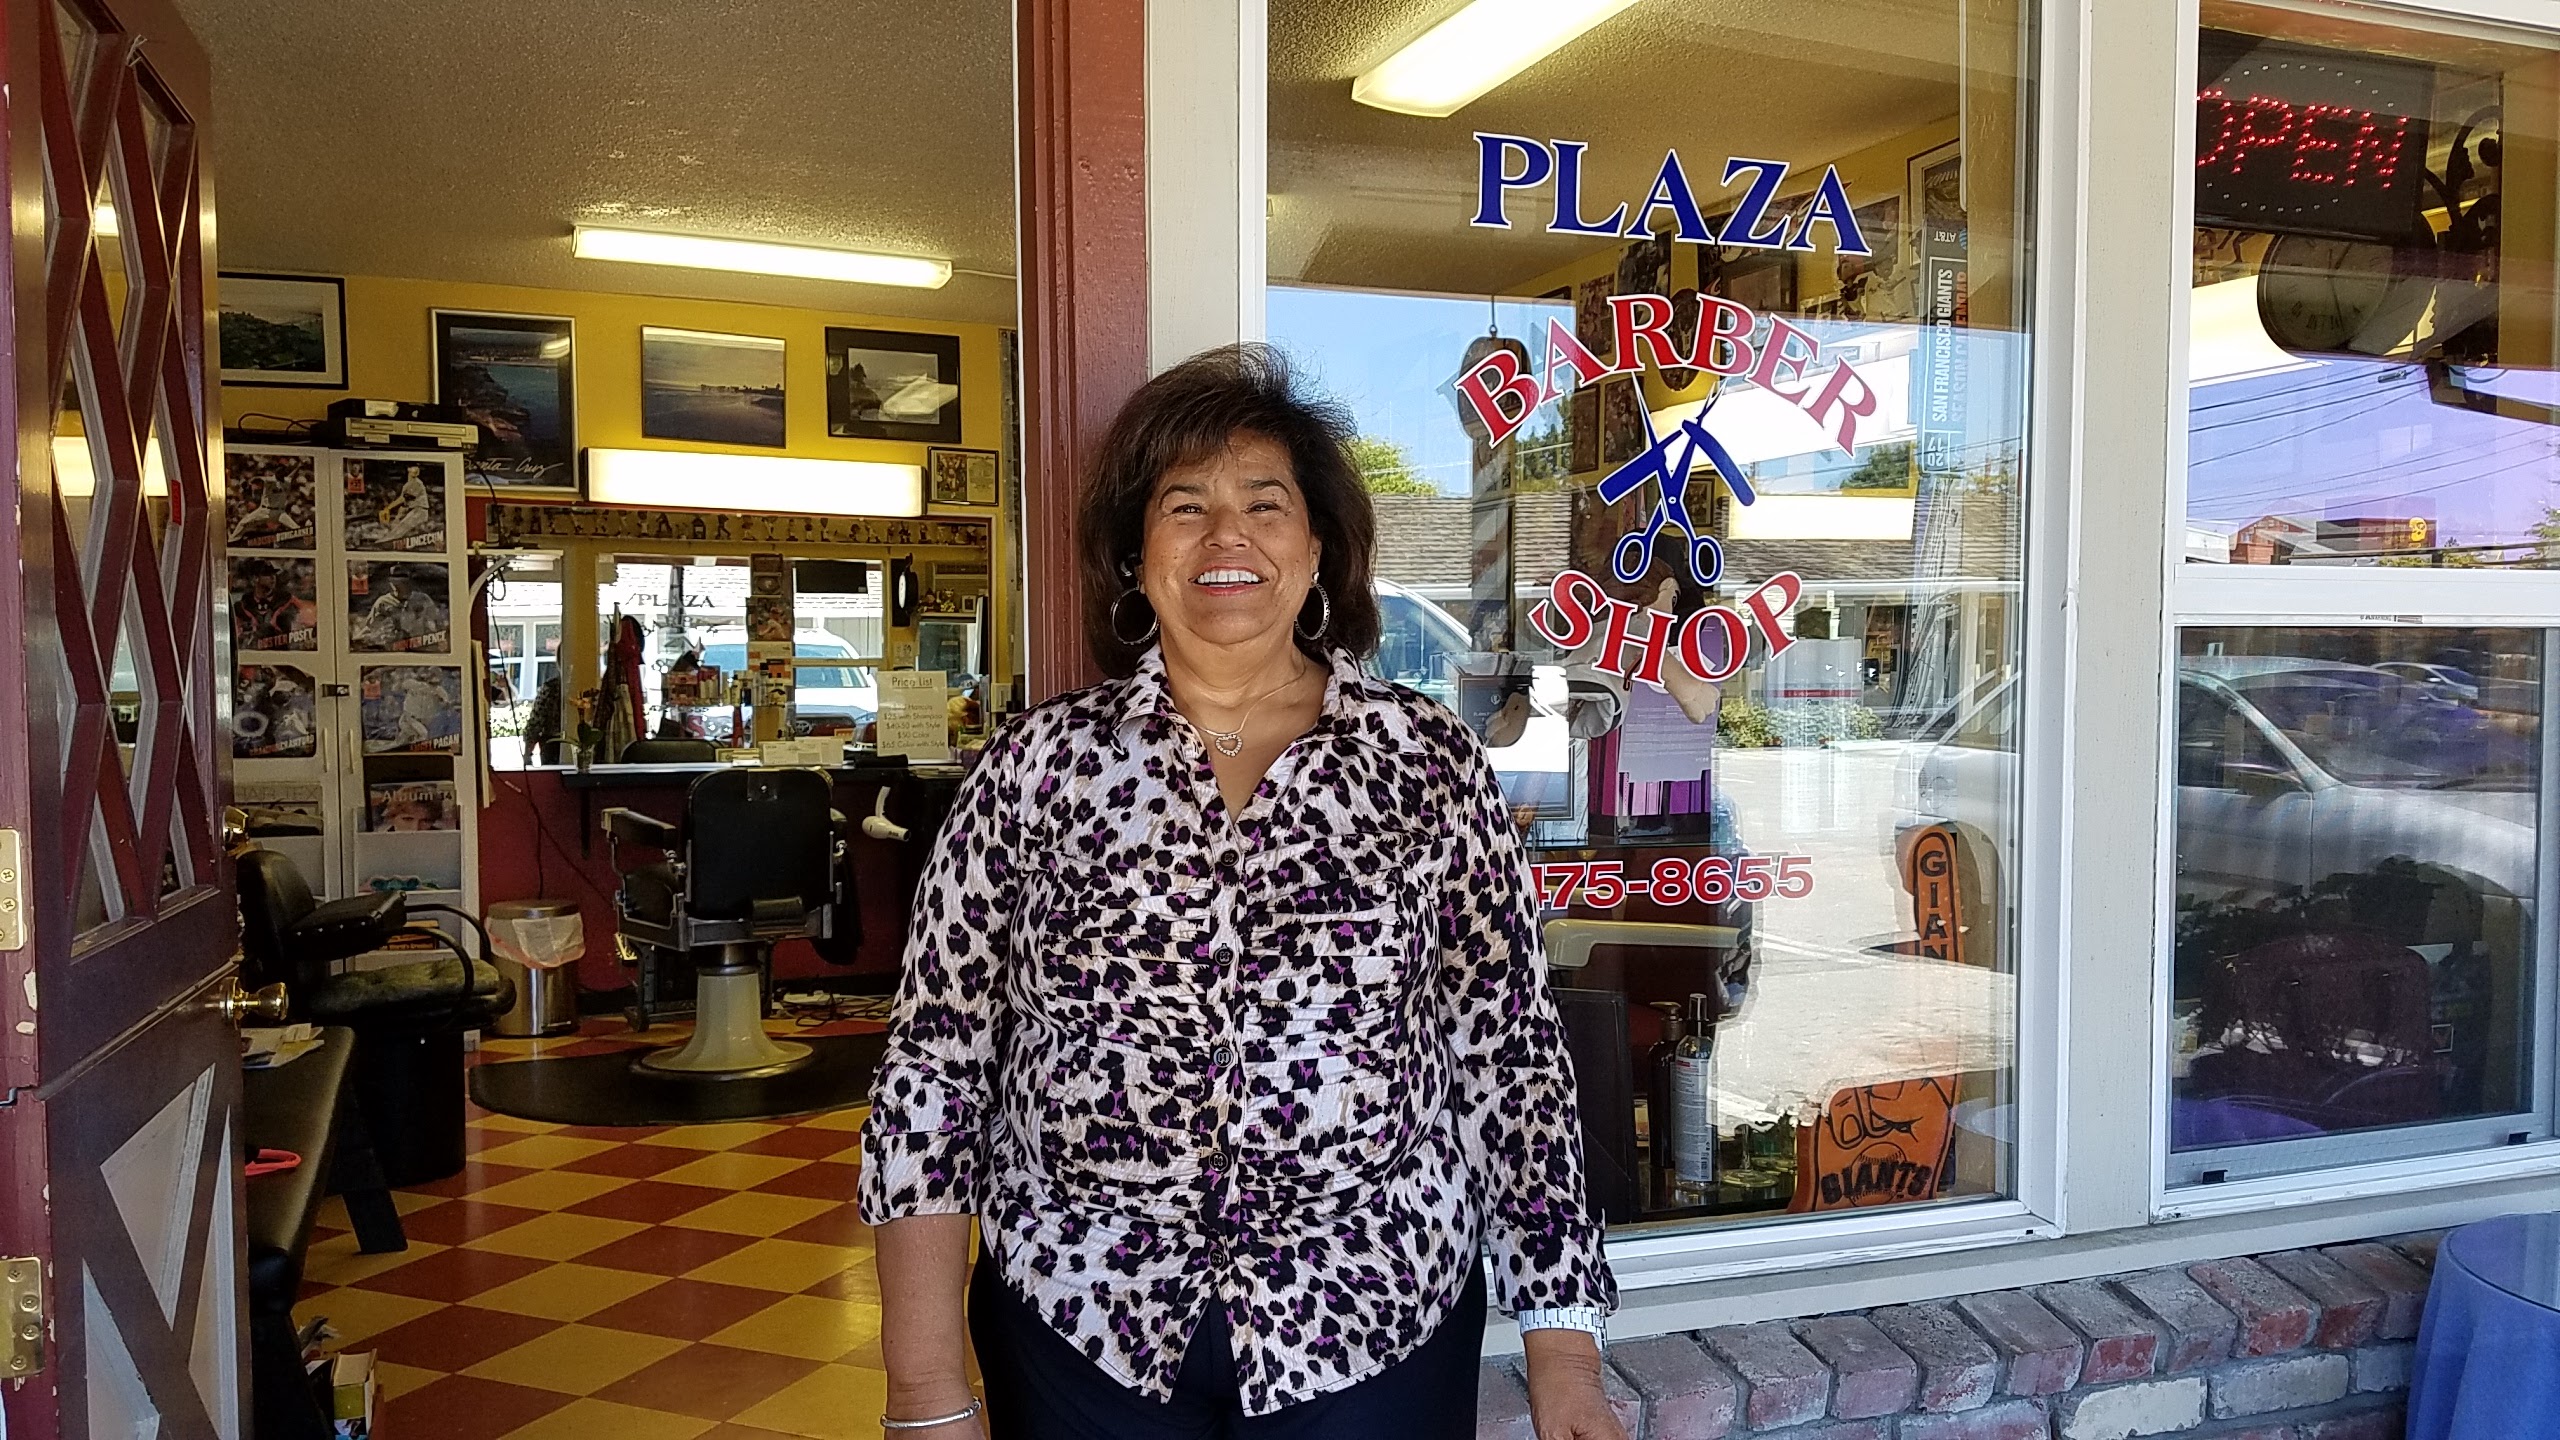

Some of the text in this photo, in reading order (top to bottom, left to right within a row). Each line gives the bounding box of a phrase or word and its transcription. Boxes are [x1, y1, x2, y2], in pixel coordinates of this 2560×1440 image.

[2195, 89, 2410, 189] OPEN
[1470, 131, 1873, 257] PLAZA
[1934, 230, 1956, 243] AT&T
[1453, 292, 1879, 459] BARBER
[1932, 268, 1952, 422] SAN FRANCISCO GIANTS
[516, 456, 564, 479] Cruz
[1528, 569, 1805, 688] SHOP
[892, 677, 933, 687] Price List
[433, 733, 460, 749] PAGAN
[1820, 1160, 1932, 1204] GIANTS
